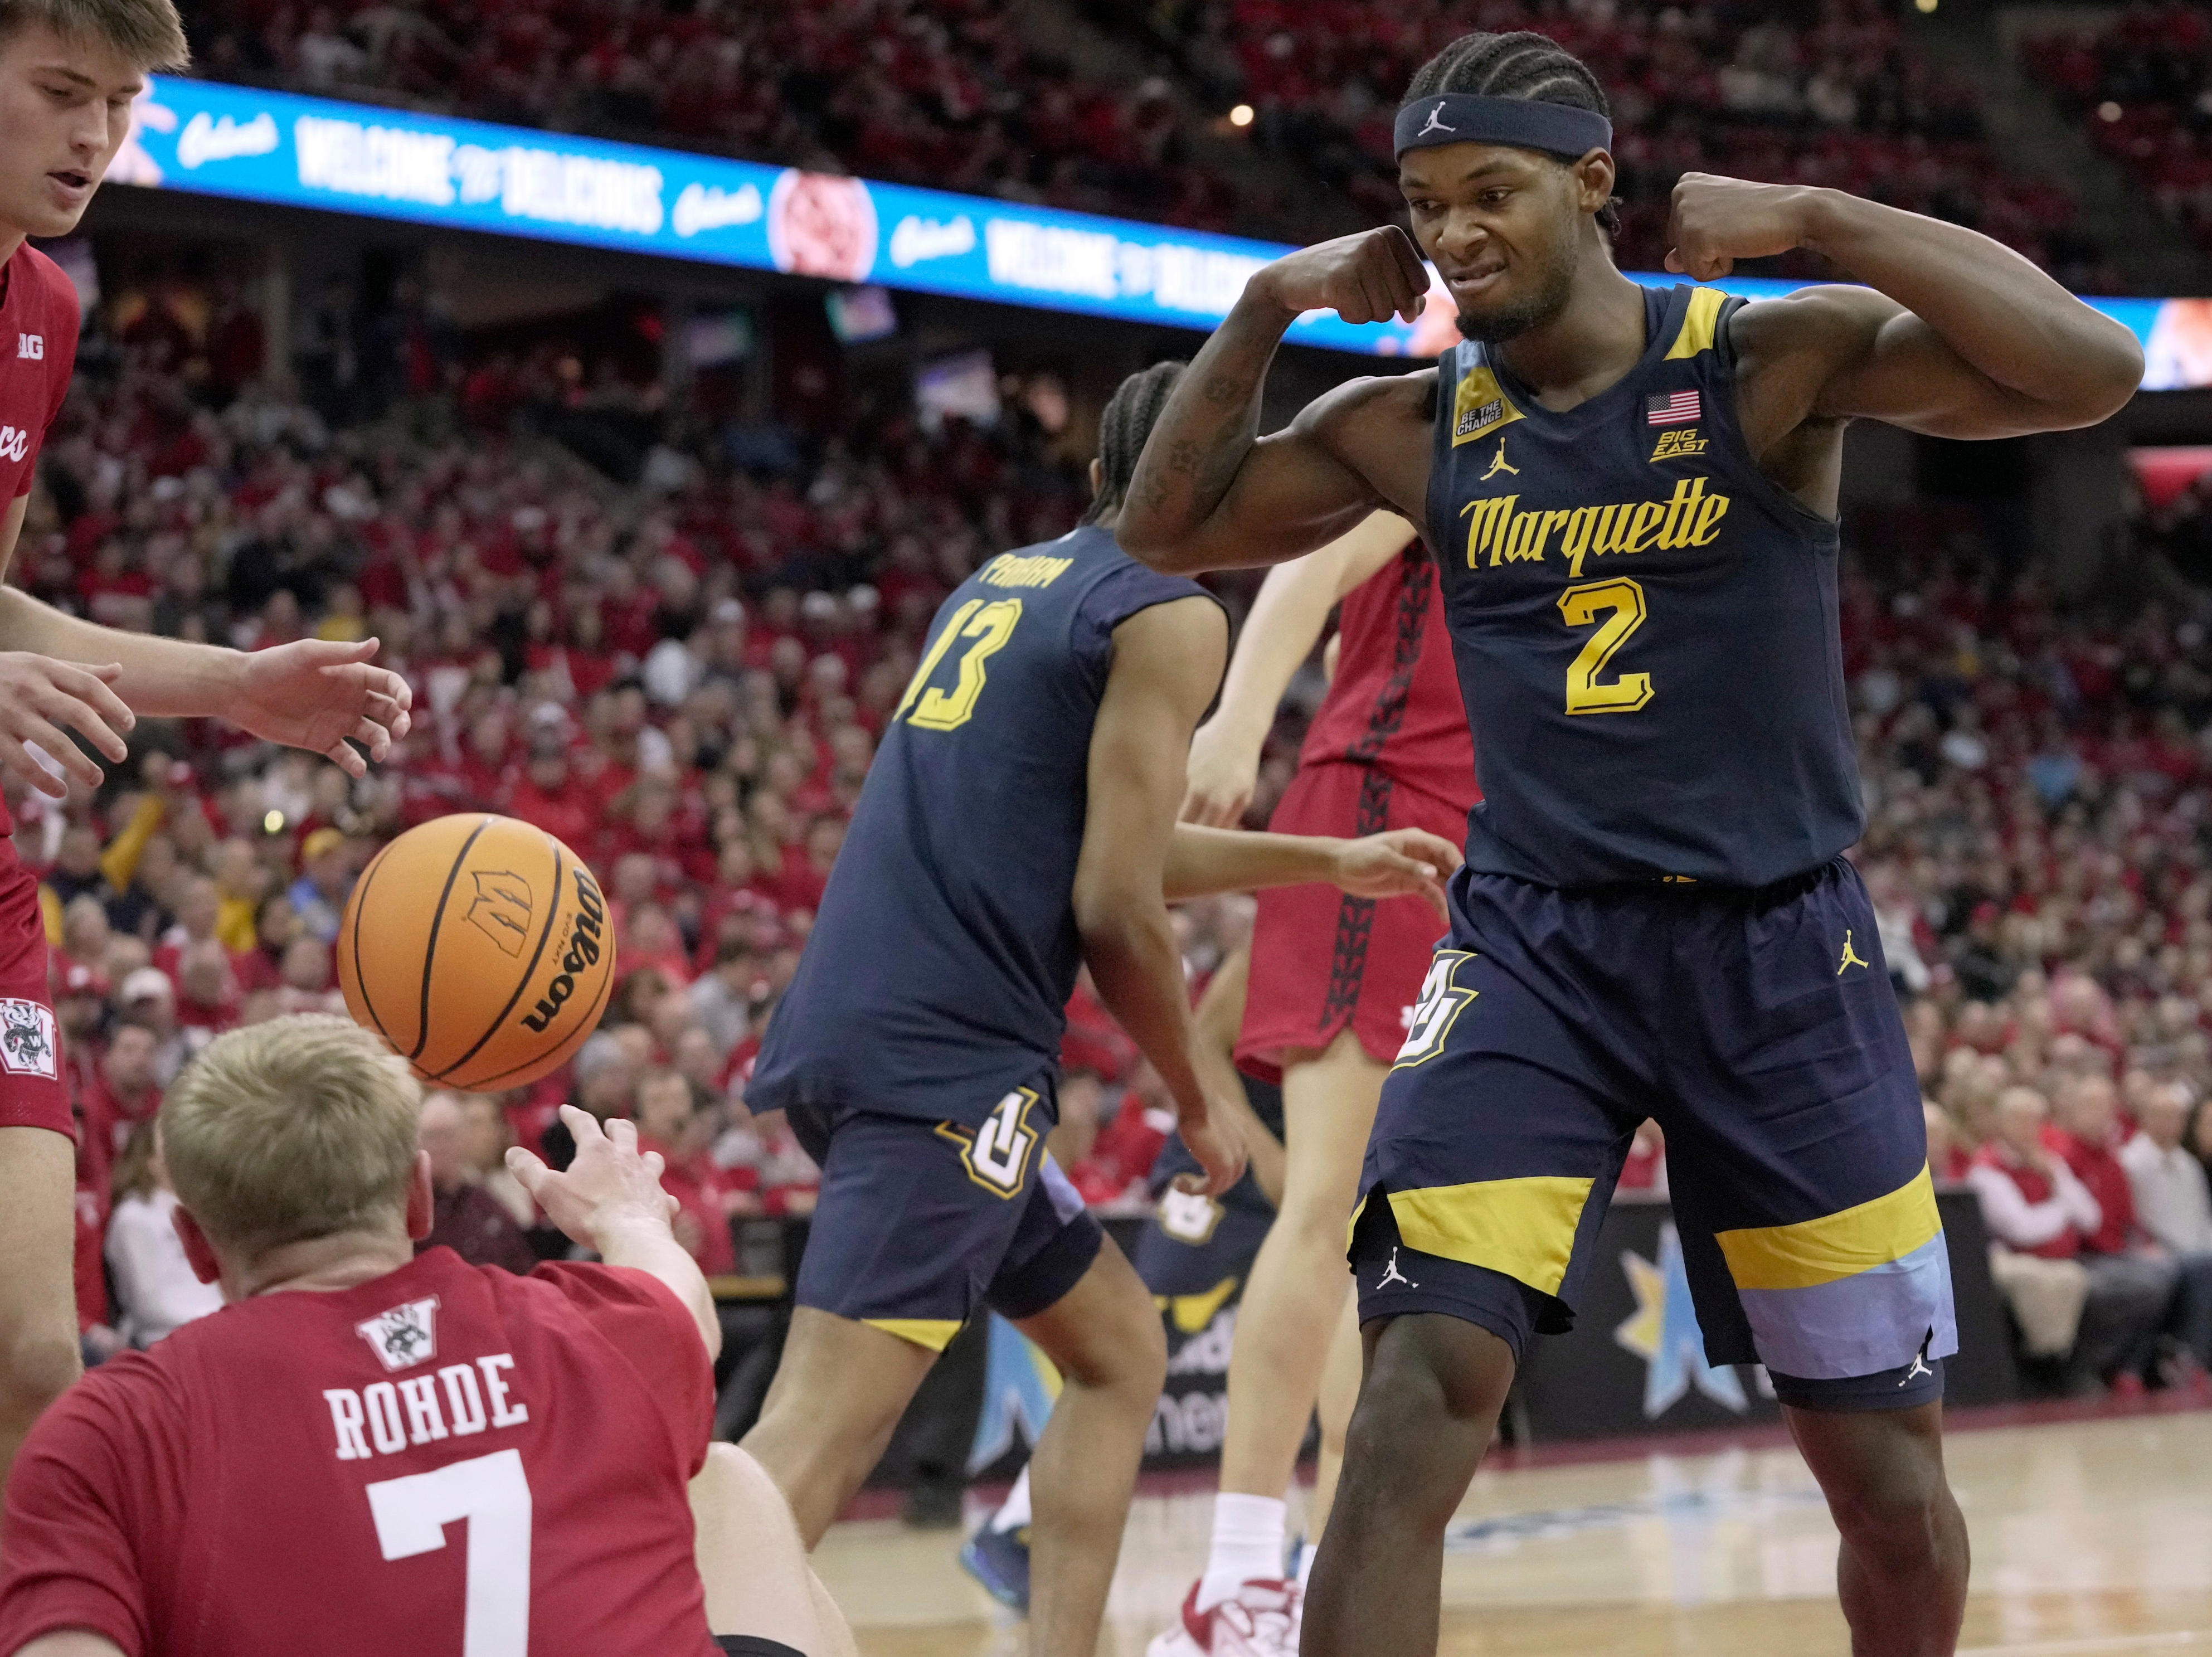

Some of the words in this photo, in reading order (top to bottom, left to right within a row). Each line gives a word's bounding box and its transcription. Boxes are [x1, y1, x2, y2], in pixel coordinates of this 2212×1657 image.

[1457, 408, 1502, 436] CHANGE
[1461, 409, 1476, 424] BE
[1480, 399, 1500, 417] THE
[1652, 439, 1709, 456] EAST
[1657, 428, 1698, 445] BIG
[1460, 477, 1730, 578] Marquette
[892, 598, 1023, 732] 13
[1556, 576, 1655, 716] 2
[521, 866, 603, 1033] Wilson
[323, 1353, 529, 1460] ROHDE
[365, 1447, 533, 1657] 7
